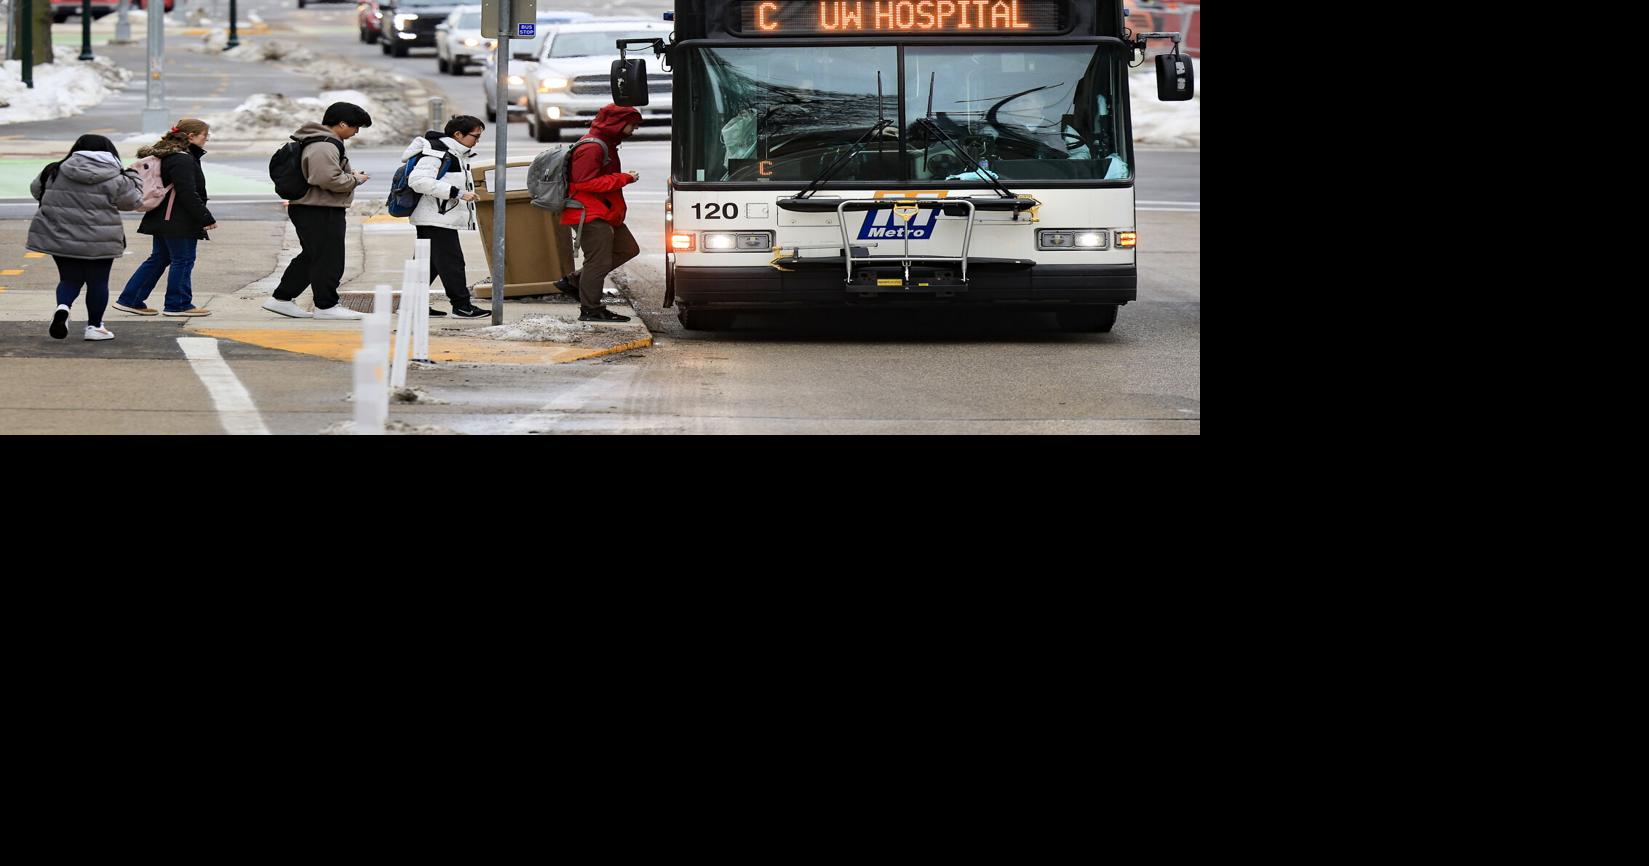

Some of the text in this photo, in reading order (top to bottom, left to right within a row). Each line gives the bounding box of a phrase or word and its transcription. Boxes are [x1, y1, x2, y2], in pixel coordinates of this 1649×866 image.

[759, 0, 1029, 30] C UW HOSPITAL
[759, 160, 773, 176] C
[691, 202, 738, 220] 120
[867, 227, 925, 238] Metro
